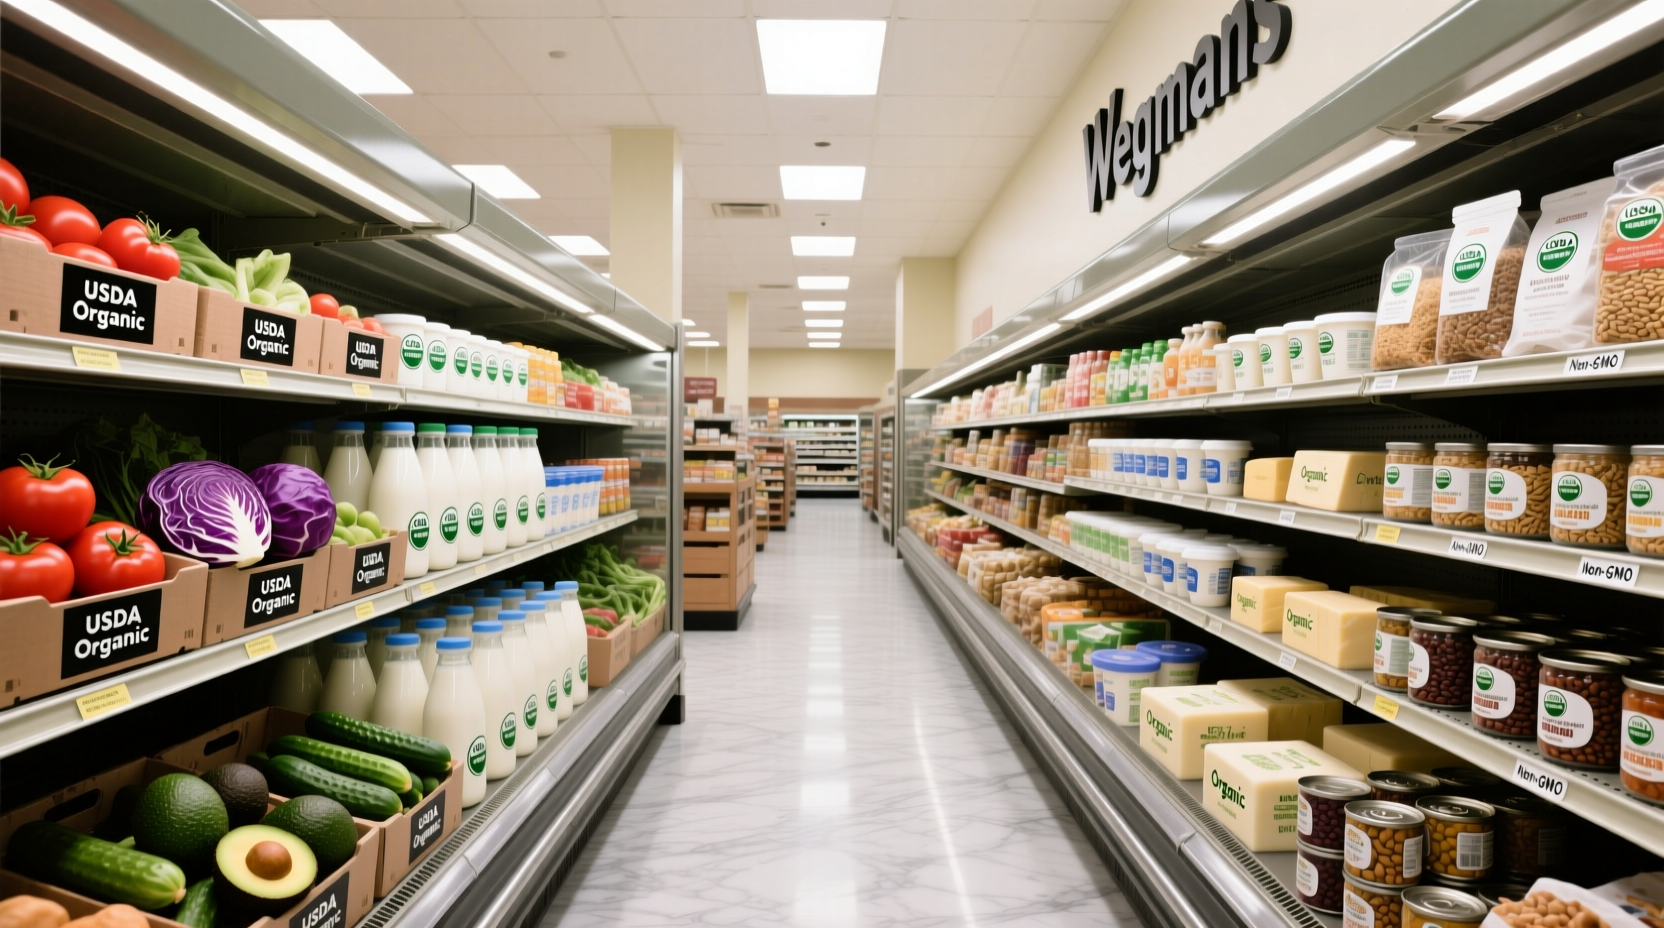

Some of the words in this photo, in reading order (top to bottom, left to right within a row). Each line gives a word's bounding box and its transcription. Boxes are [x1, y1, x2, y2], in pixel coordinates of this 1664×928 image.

[1082, 0, 1293, 213] Wegmans
[84, 279, 138, 308] USDA
[73, 299, 145, 330] Organic
[255, 318, 286, 339] USDA
[247, 334, 290, 355] Organic
[261, 574, 292, 596] USDA
[1582, 561, 1633, 582] Non-GMO
[252, 593, 295, 615] Organic
[85, 605, 142, 634] USDA
[74, 626, 150, 659] Organic
[1211, 768, 1246, 810] Organic
[302, 892, 337, 928] USDA
